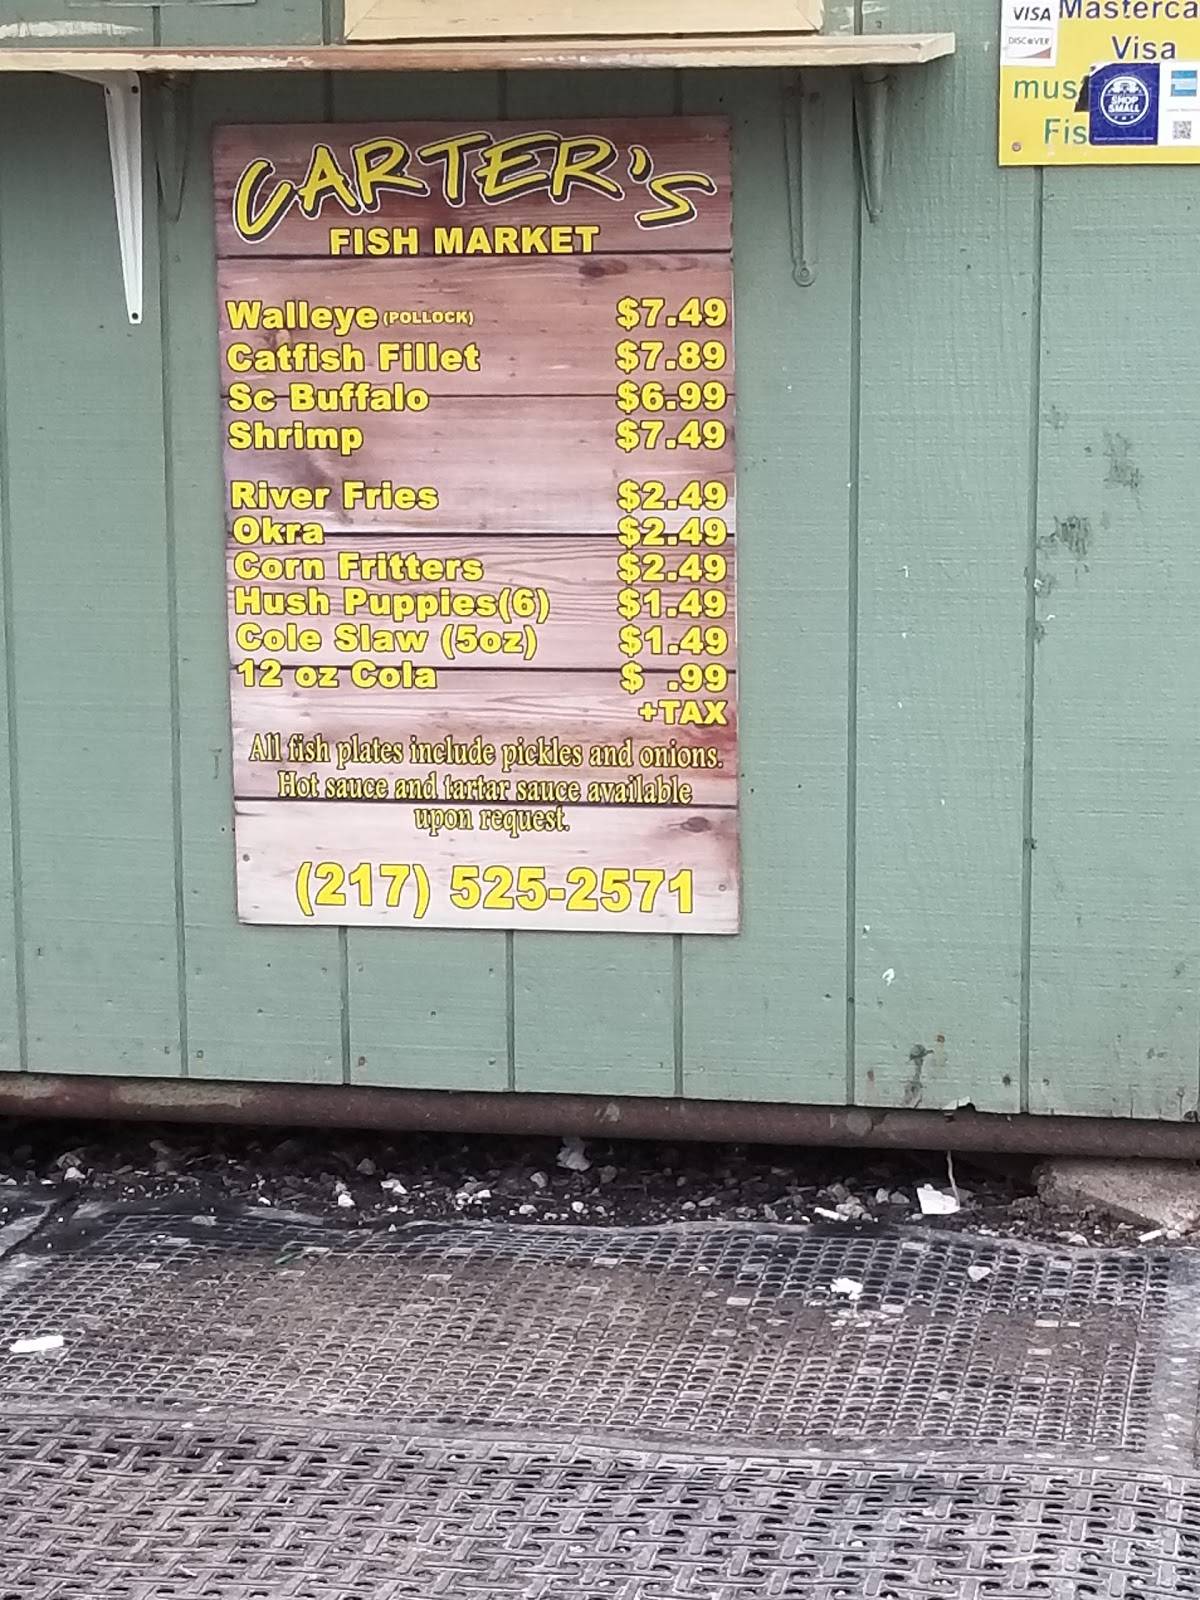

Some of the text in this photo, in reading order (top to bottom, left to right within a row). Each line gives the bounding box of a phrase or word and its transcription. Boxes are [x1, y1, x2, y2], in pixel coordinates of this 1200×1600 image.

[1014, 7, 1050, 21] VISA
[1112, 36, 1176, 60] Visa
[1109, 104, 1140, 113] SMALL
[1111, 96, 1138, 105] SHOP
[330, 226, 600, 255] FISH MARKET
[227, 302, 474, 335] Walleye (POLLOCK)
[616, 297, 727, 332] $7.49
[227, 344, 480, 372] Catfish Fillet
[616, 340, 727, 375] $7.89
[228, 383, 429, 412] Sc Buffalo
[616, 381, 727, 414] $6.99
[228, 422, 363, 456] Shrimp
[616, 420, 727, 452] $7.49
[231, 481, 439, 509] River Fries
[617, 480, 728, 512] $2.49
[233, 517, 325, 544] Okra
[617, 518, 728, 549] $2.49
[234, 552, 484, 581] Corn Fritters
[617, 553, 728, 585] $2.49
[234, 588, 550, 623] Hush Puppies(6)
[617, 588, 728, 621] $1.49
[236, 623, 538, 659] Cole Slaw (5oz)
[618, 626, 728, 657] $1.49
[237, 660, 437, 689] 12 oz Cola
[638, 700, 727, 725] +TAX
[249, 733, 723, 771] All fish plates include pickles and onions.
[278, 772, 692, 805] Hot sauce and tartar sauce available
[414, 808, 570, 838] upon request.
[295, 861, 693, 918] (217) 525-2571
